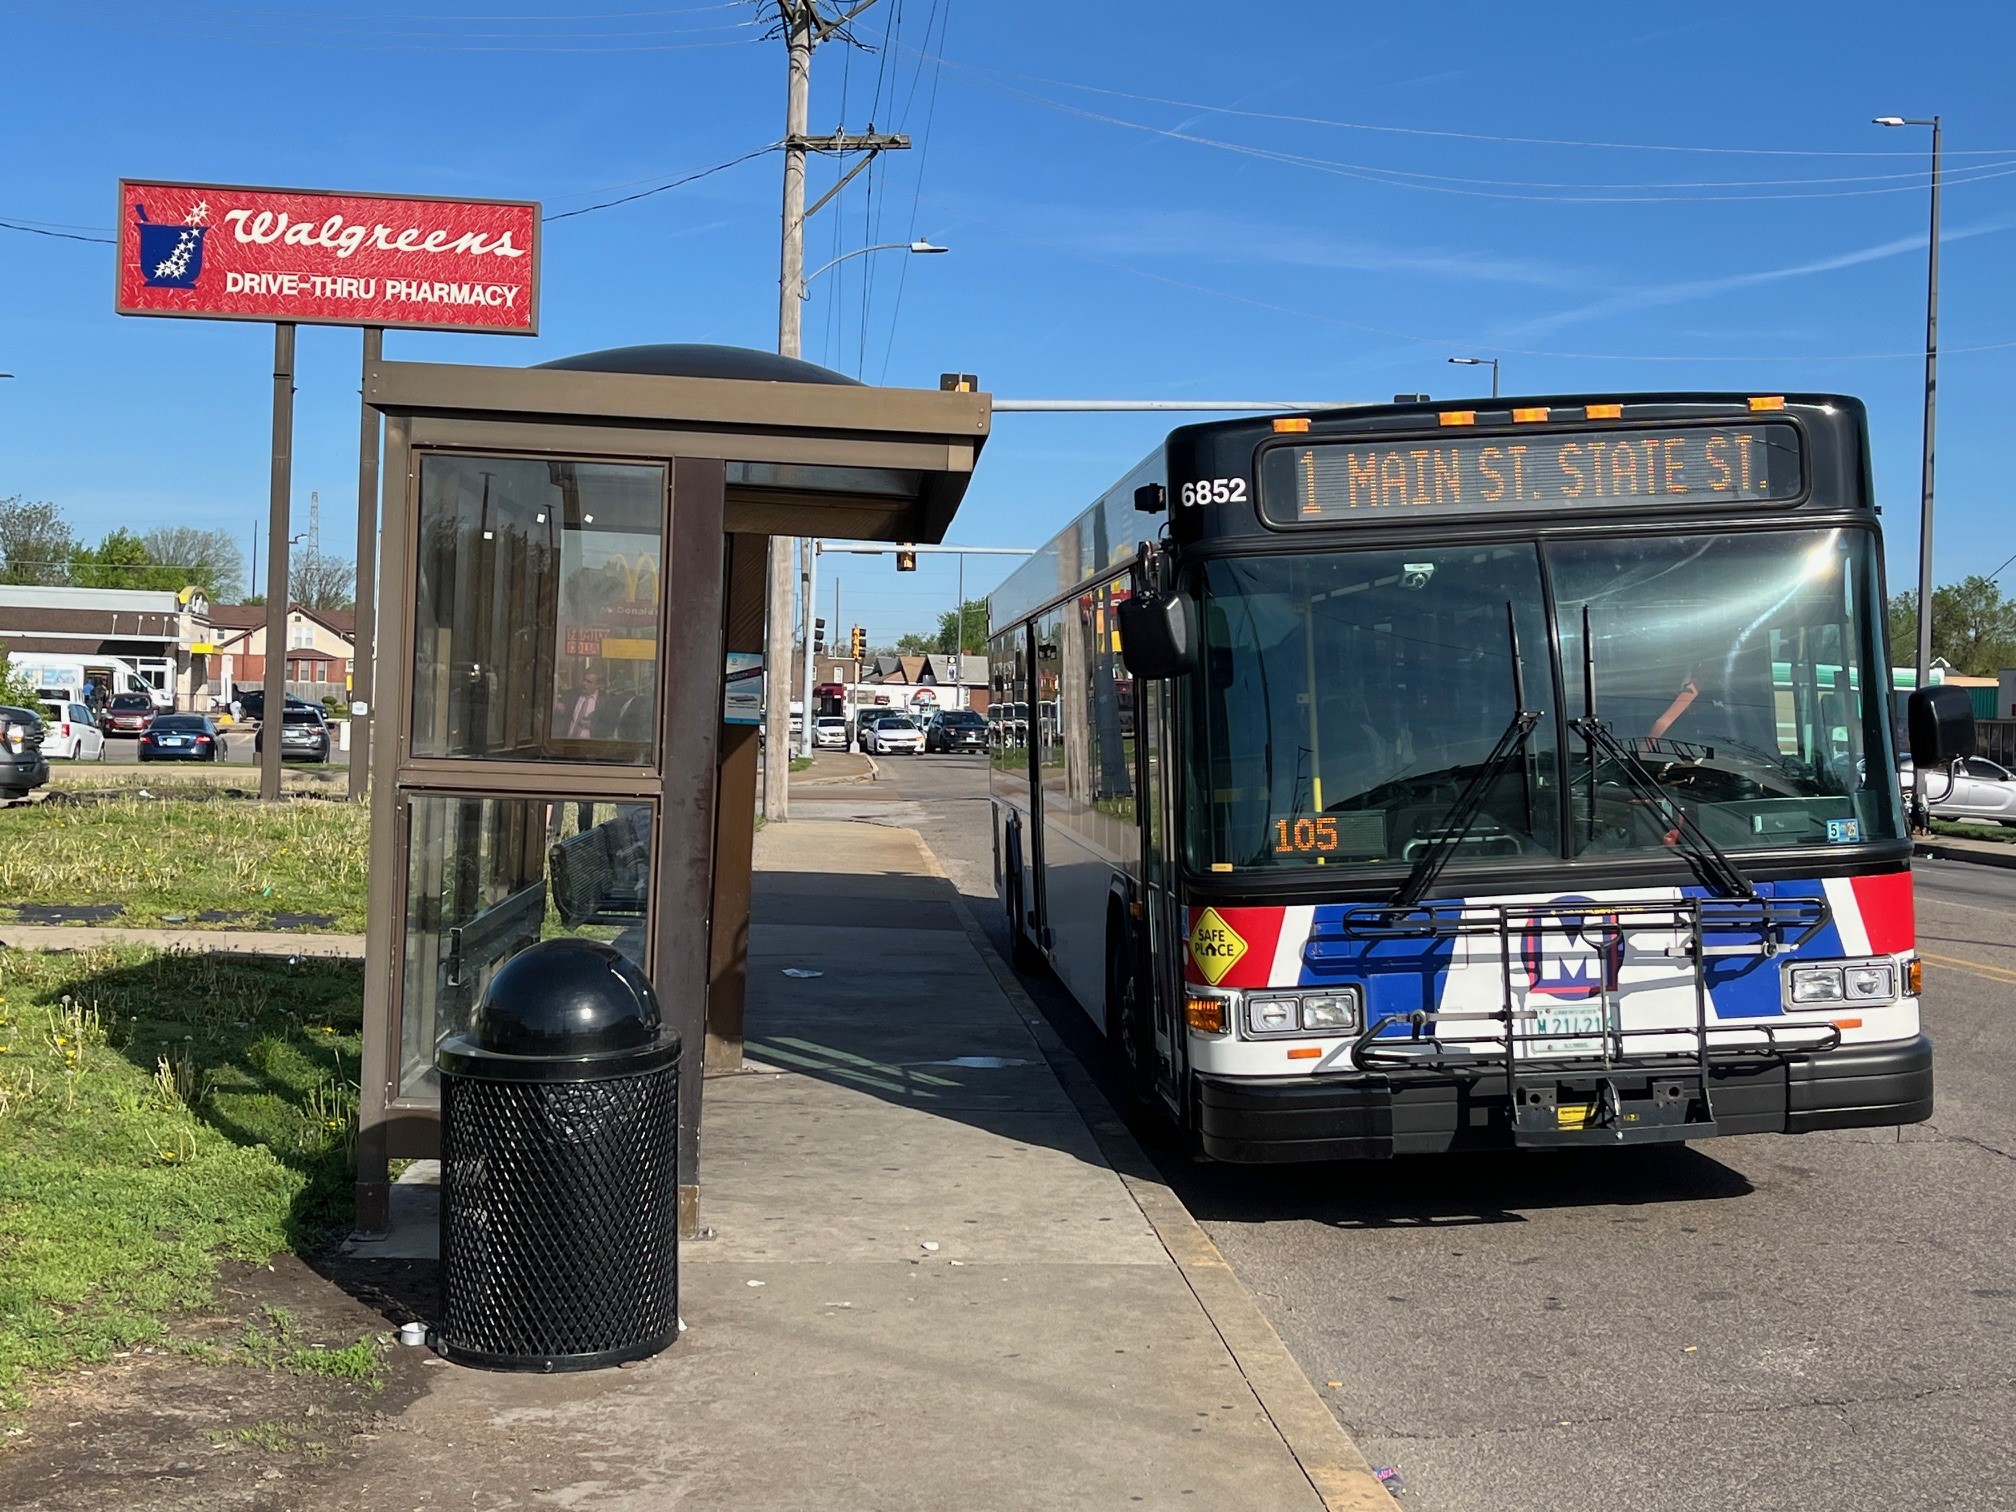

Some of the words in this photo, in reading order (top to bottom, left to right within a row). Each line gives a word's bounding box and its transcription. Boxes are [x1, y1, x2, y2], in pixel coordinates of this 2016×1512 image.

[224, 209, 526, 259] Walgreens
[225, 272, 376, 300] DRIVE-THRU
[385, 278, 520, 308] PHARMACY
[1300, 451, 1322, 514] 1
[1347, 448, 1461, 508] MAIN
[1478, 445, 1541, 501] ST.
[1558, 437, 1689, 498] STATE
[1705, 434, 1768, 491] ST.
[1181, 477, 1247, 507] 6852
[1275, 817, 1338, 852] 105
[1831, 824, 1837, 836] 5
[1198, 929, 1226, 942] SAFE
